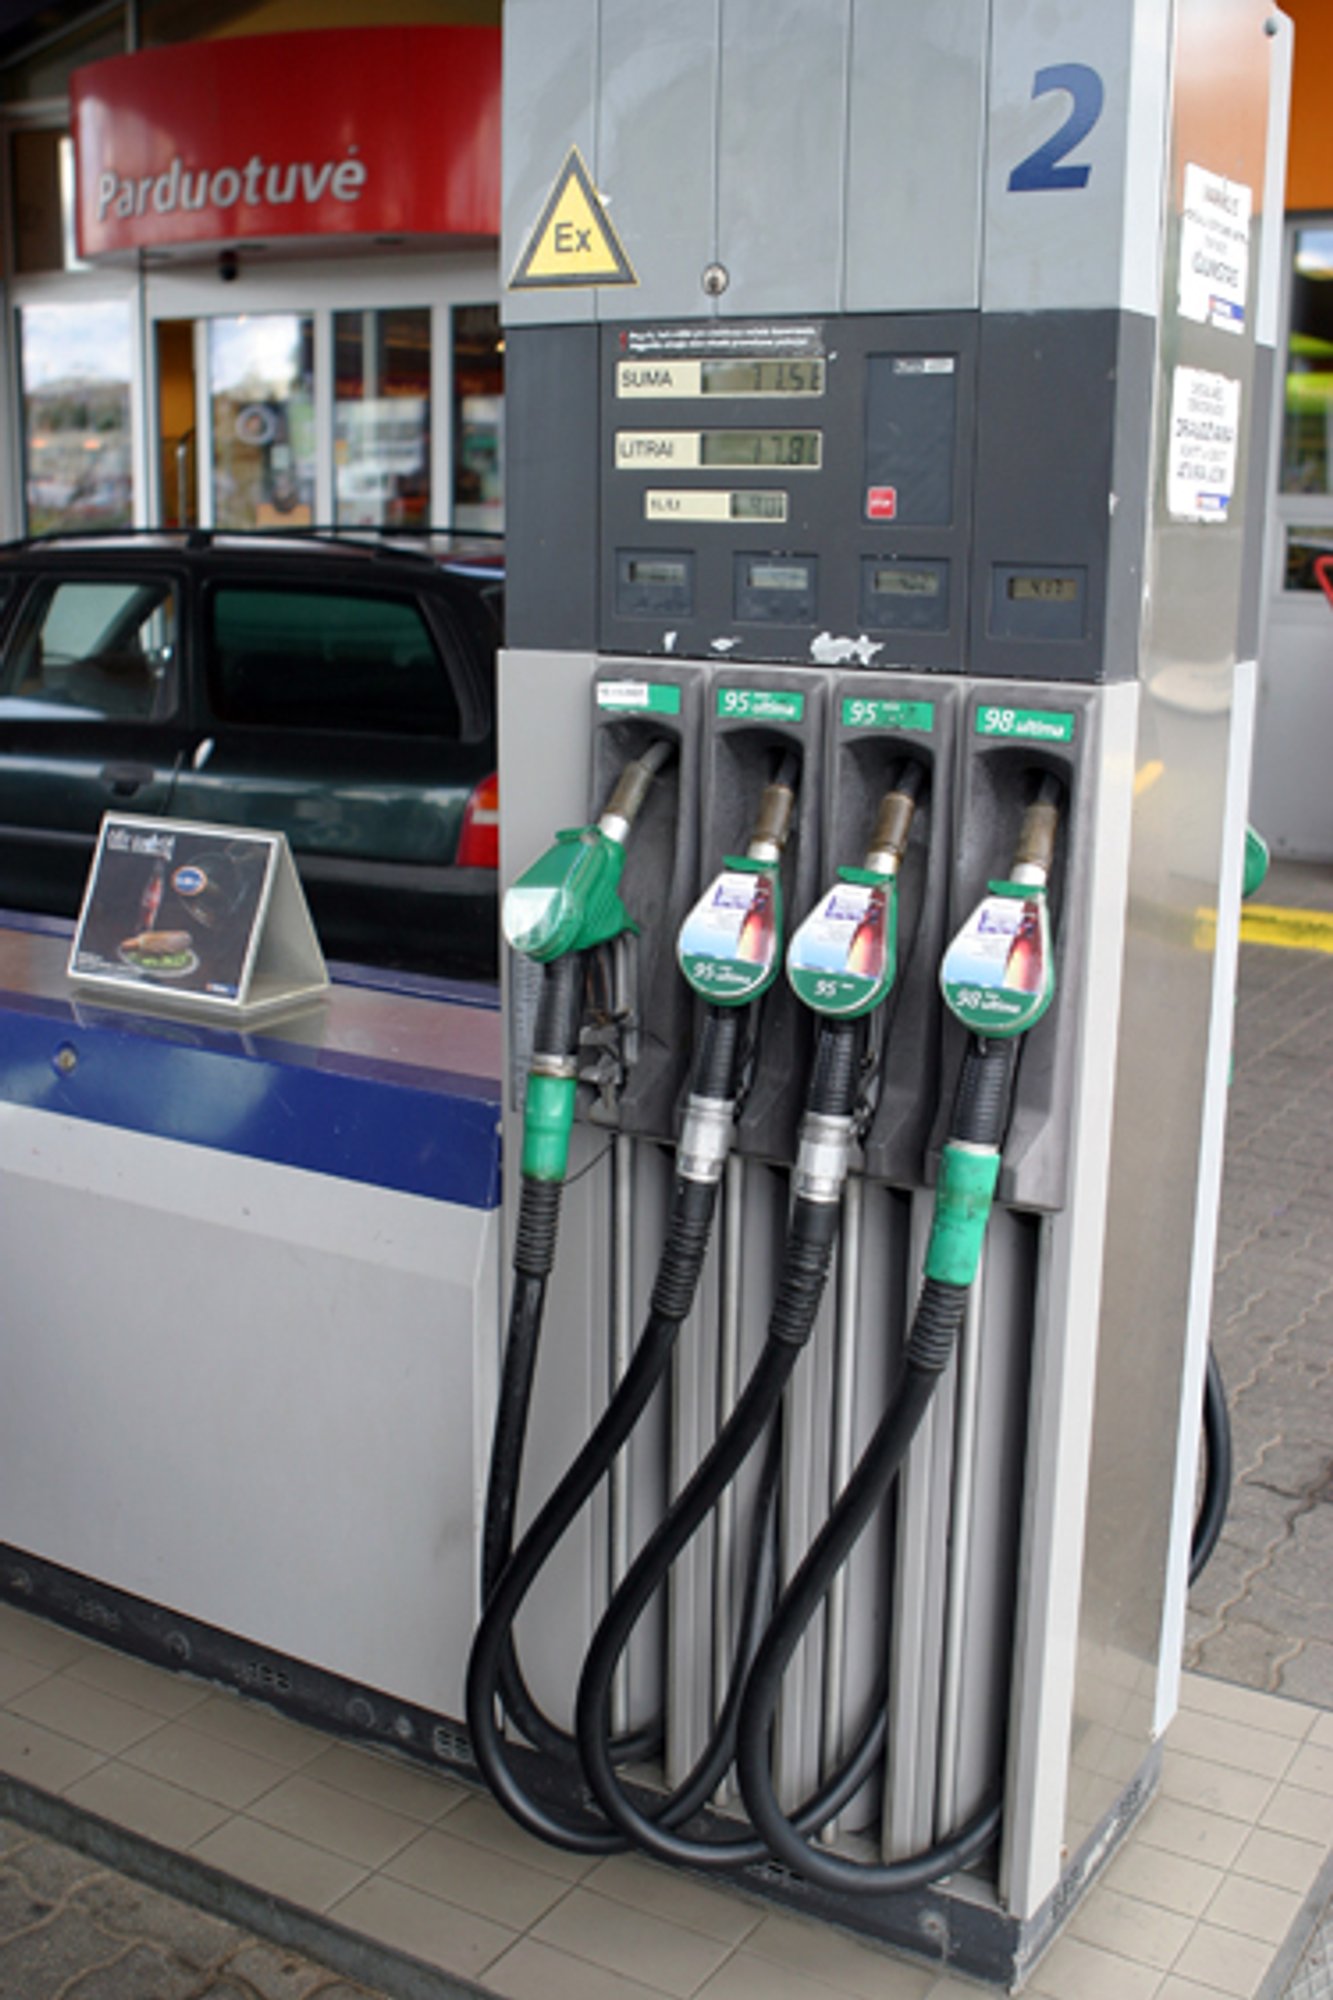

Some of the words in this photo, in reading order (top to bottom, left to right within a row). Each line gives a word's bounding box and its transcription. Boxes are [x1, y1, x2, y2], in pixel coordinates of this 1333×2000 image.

[1007, 63, 1104, 192] 2
[97, 145, 367, 220] Parduotuvė
[554, 222, 592, 253] Ex
[621, 369, 673, 389] SUMA
[619, 439, 674, 459] LITRAI
[724, 690, 750, 714] 95
[850, 701, 878, 724] 95
[984, 708, 1015, 733] 98
